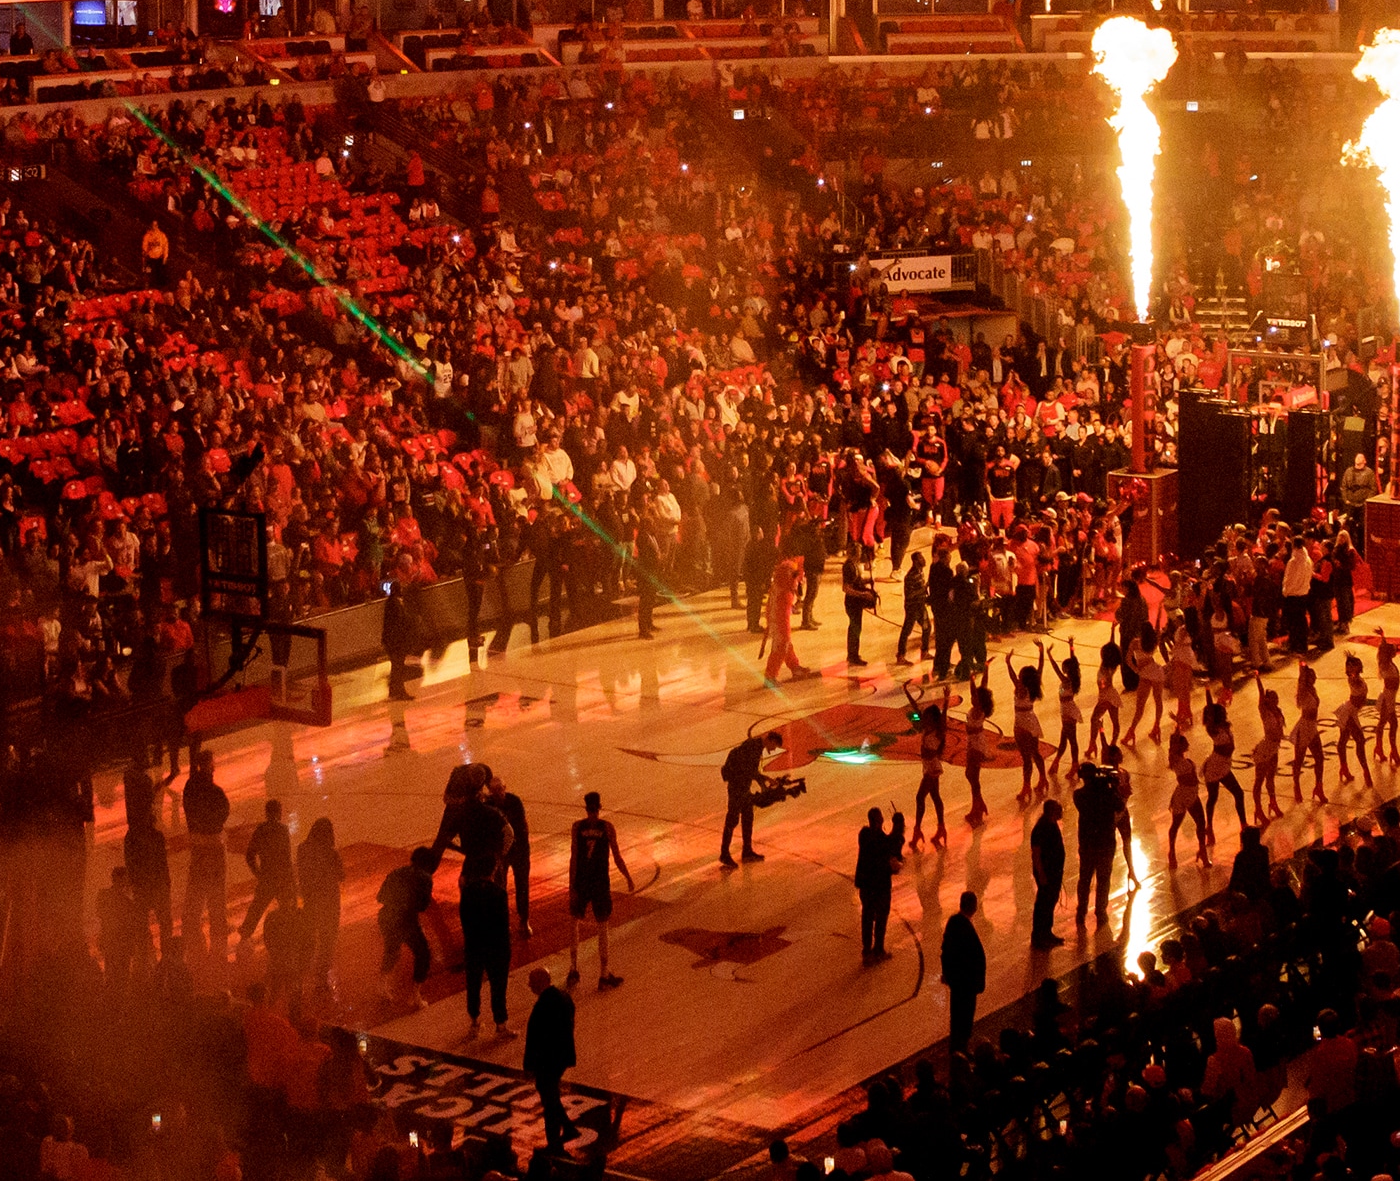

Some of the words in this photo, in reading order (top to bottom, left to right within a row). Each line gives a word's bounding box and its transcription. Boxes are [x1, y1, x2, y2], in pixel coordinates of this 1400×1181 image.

[886, 267, 946, 282] Advocate
[1279, 319, 1307, 328] TISSOT
[586, 839, 597, 859] 7
